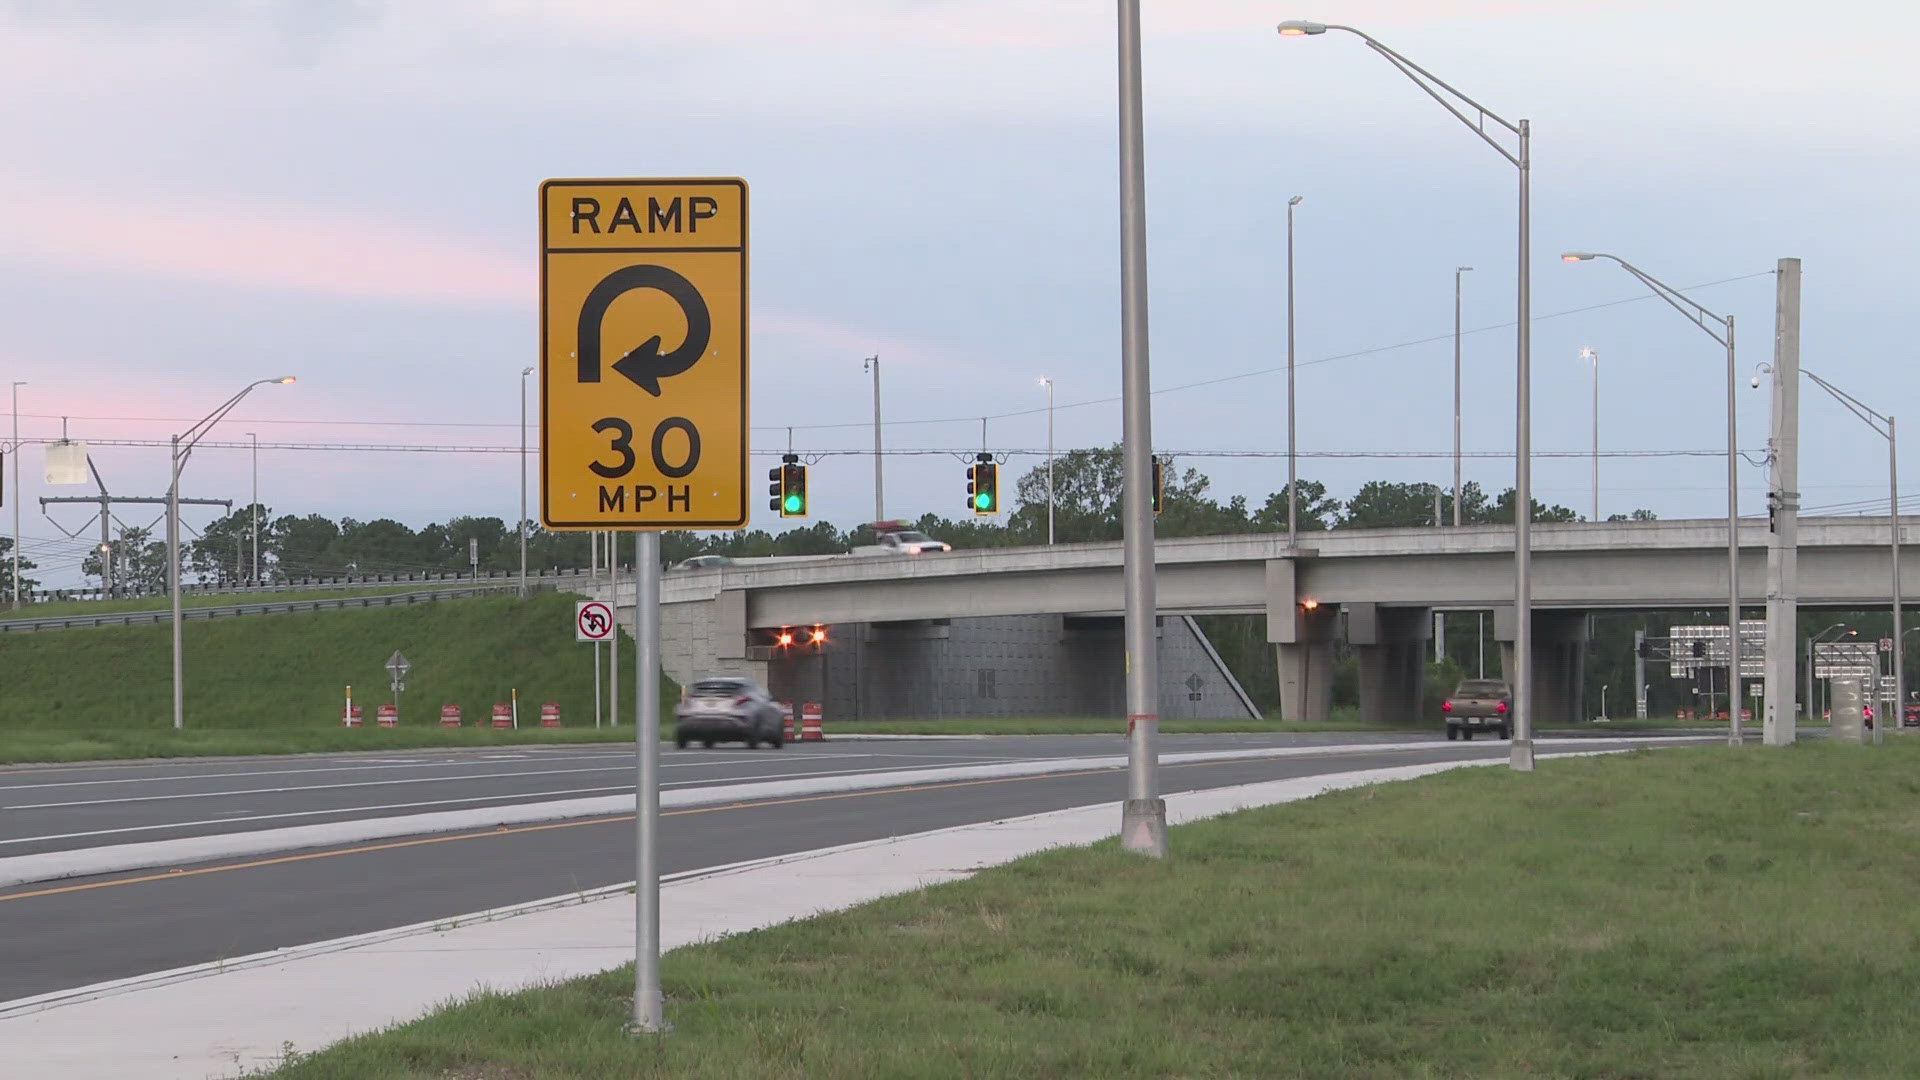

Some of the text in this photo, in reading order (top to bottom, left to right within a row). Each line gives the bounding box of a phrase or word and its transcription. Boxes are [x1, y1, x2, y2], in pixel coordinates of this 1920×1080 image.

[572, 197, 717, 234] RAMP
[588, 417, 701, 479] 30
[599, 485, 690, 513] MPH
